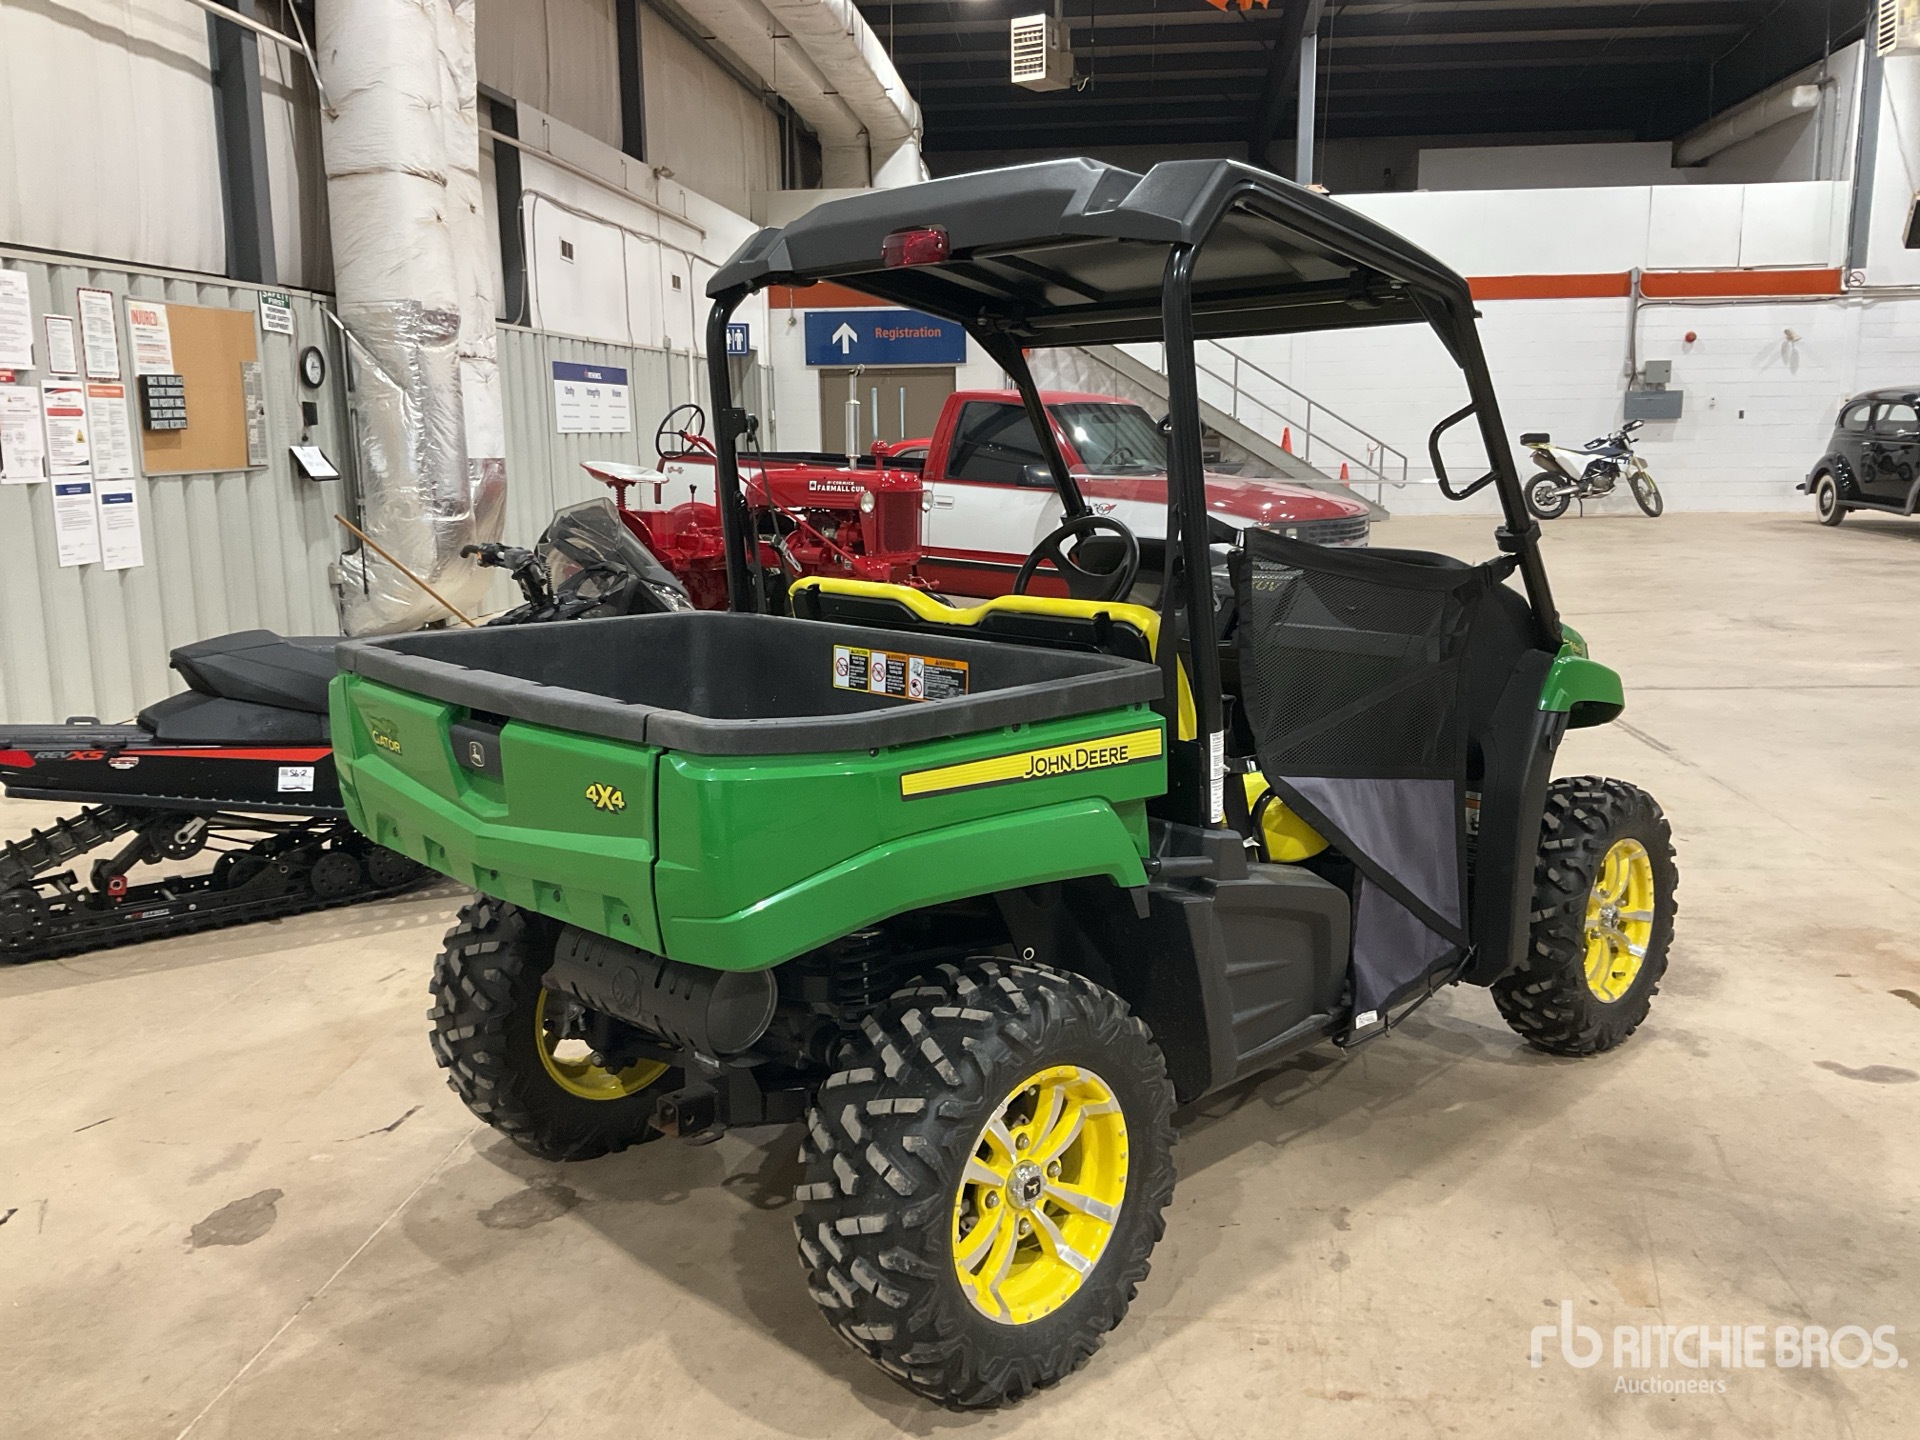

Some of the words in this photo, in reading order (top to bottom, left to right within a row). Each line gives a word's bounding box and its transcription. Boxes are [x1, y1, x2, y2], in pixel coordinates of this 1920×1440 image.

[268, 297, 285, 307] FIRST
[875, 326, 941, 341] Registration
[372, 730, 402, 754] GATOR
[1025, 753, 1072, 776] JOHN
[1075, 745, 1129, 768] DEERE
